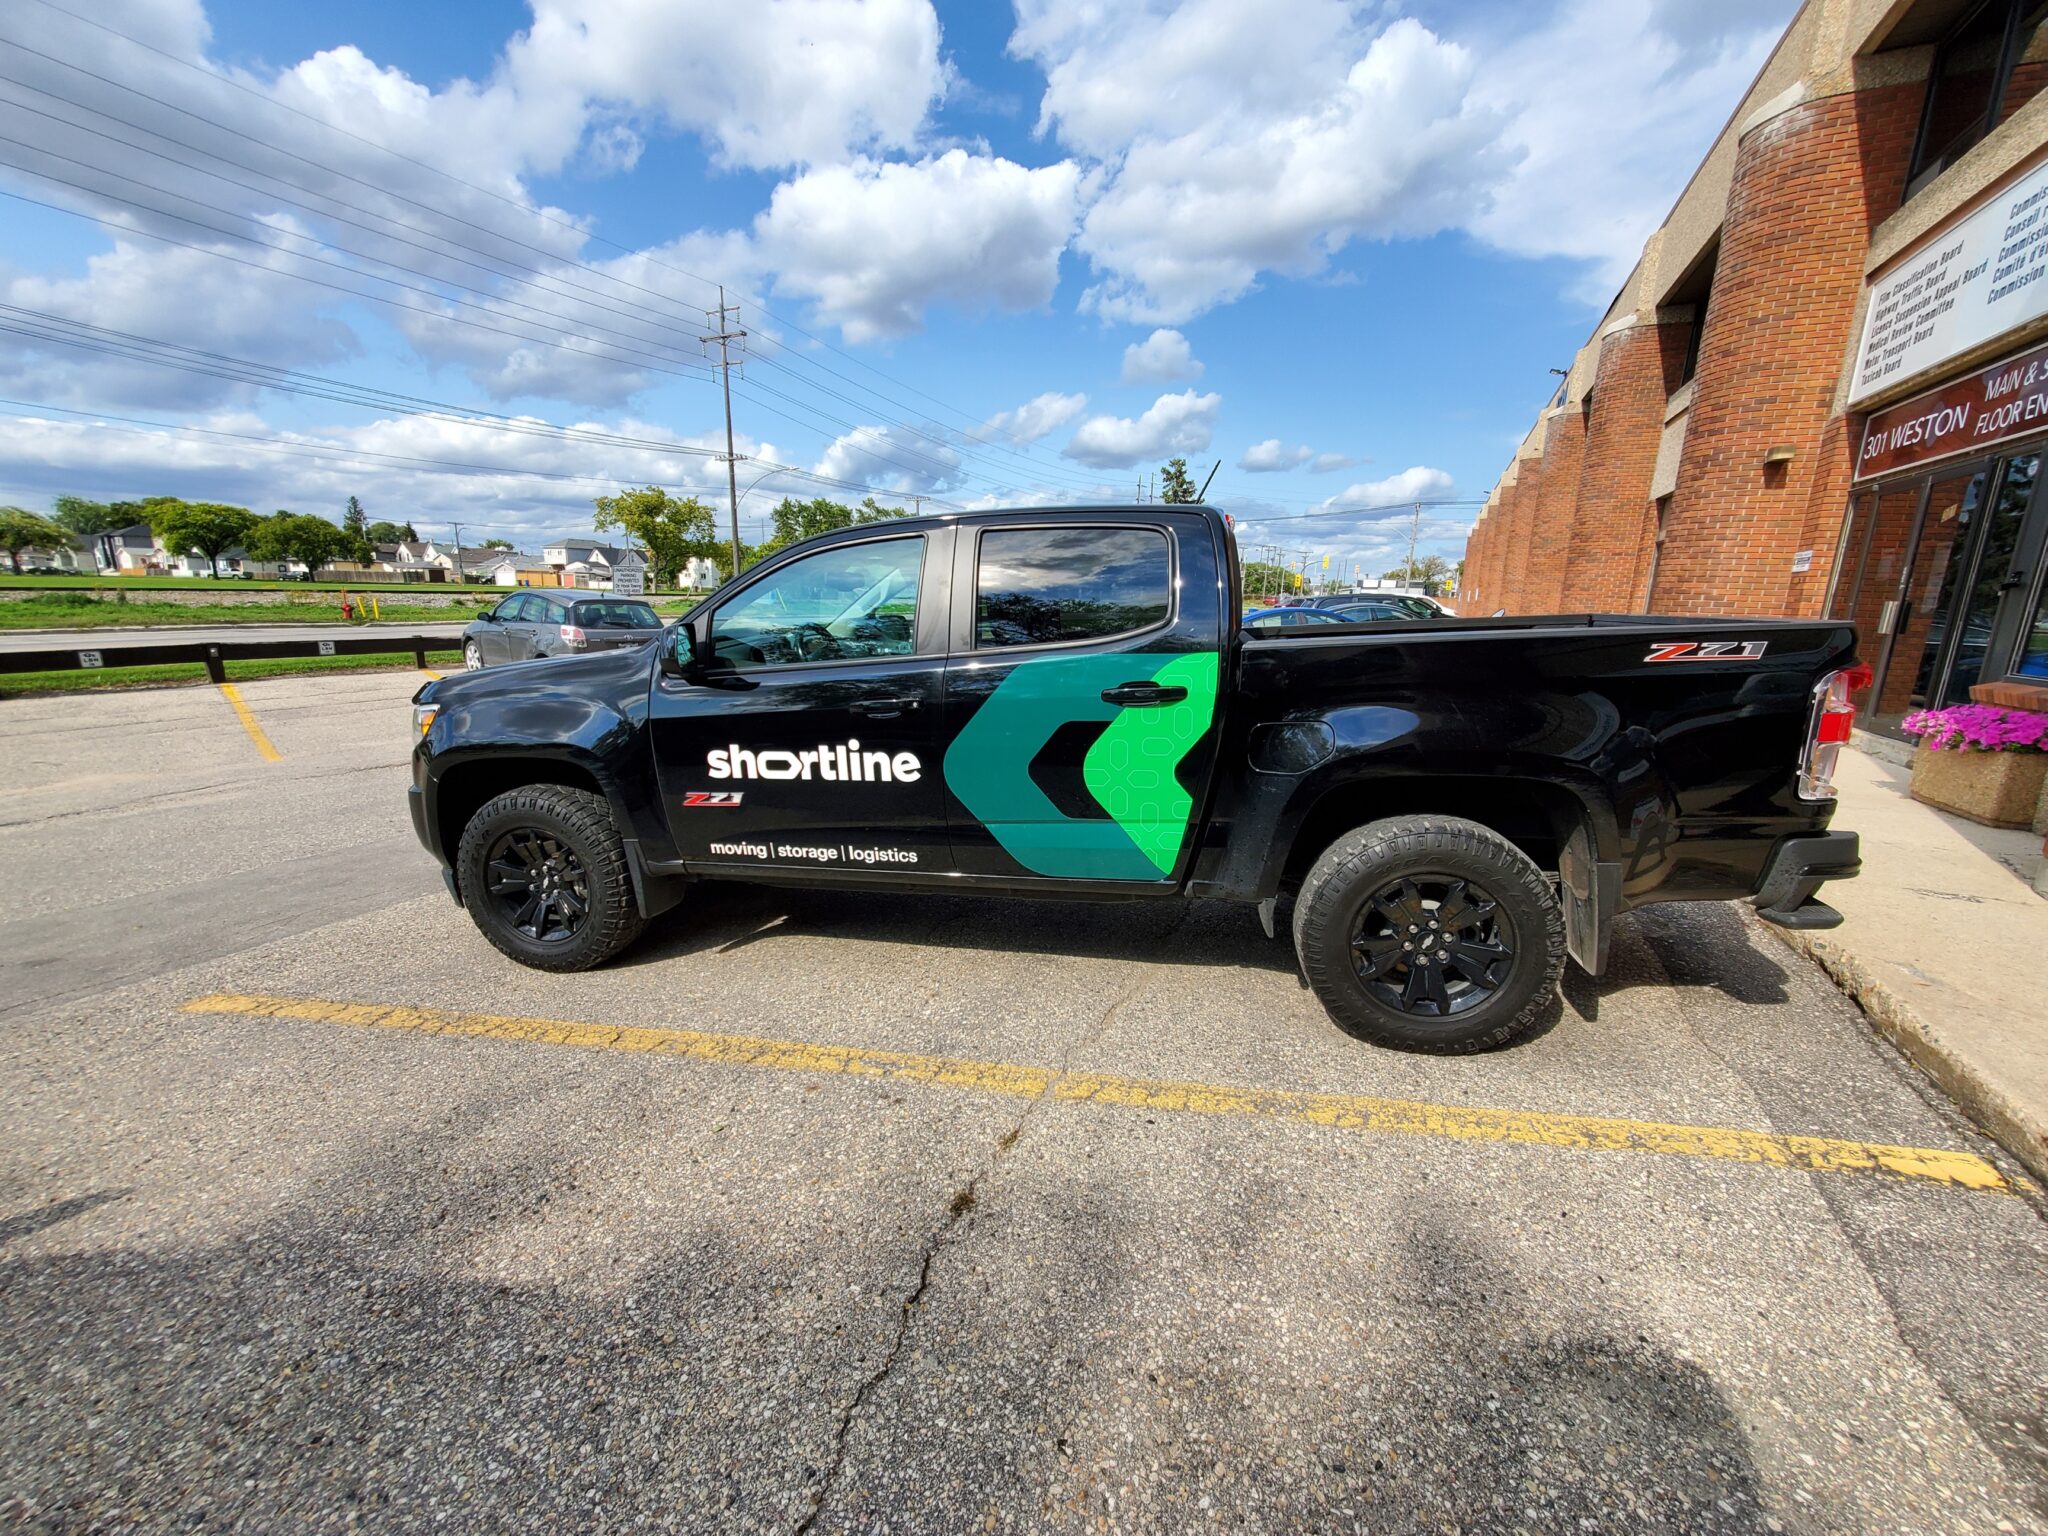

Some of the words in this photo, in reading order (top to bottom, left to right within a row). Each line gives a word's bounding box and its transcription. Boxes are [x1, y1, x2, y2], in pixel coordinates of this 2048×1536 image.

[2004, 206, 2041, 241] Conseil
[1879, 291, 1891, 306] Film
[1892, 259, 1938, 297] Classification
[1940, 240, 1964, 266] Board
[1987, 265, 2045, 305] Commission
[1993, 252, 2027, 284] Comité
[1871, 318, 1893, 339] Licence
[1894, 295, 1932, 325] Suspension
[1934, 274, 1962, 301] Appeal
[1962, 257, 1989, 285] Board
[1875, 301, 1899, 323] Highway
[1901, 285, 1923, 306] Traffic
[1925, 266, 1948, 291] Board
[1864, 355, 1881, 371] Motor
[1882, 336, 1912, 361] Transport
[1913, 322, 1935, 345] Board
[1867, 333, 1890, 355] Medical
[1890, 321, 1914, 346] Review
[1915, 298, 1955, 328] Committee
[1862, 367, 1882, 386] Taxicab
[1883, 356, 1902, 375] Board
[1985, 366, 2025, 402] MAIN
[2023, 361, 2038, 386] &
[1864, 431, 1888, 460] 301
[1890, 402, 1970, 450] WESTON
[1974, 400, 2022, 436] FLOOR
[1643, 641, 1768, 662] Z71
[707, 739, 921, 782] shortline
[683, 791, 744, 807] Z71
[710, 842, 768, 859] moving
[778, 845, 838, 862] storage
[849, 845, 918, 864] logistics
